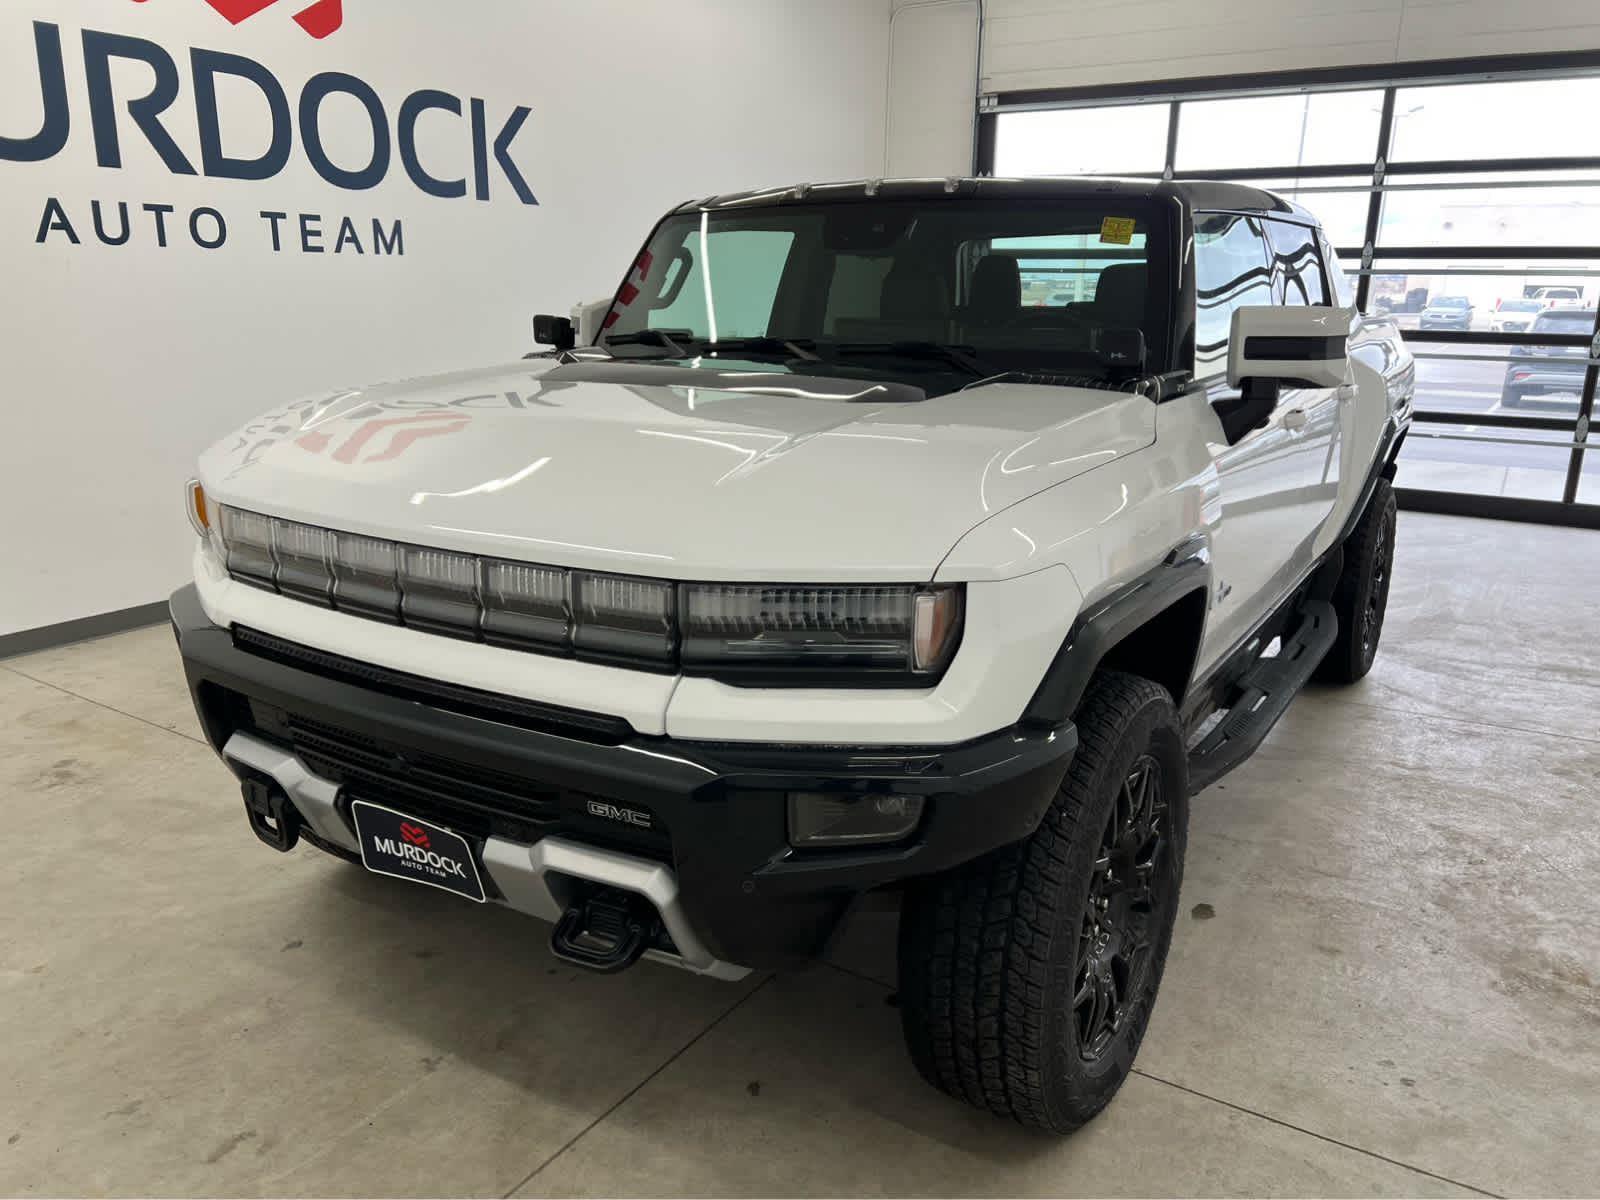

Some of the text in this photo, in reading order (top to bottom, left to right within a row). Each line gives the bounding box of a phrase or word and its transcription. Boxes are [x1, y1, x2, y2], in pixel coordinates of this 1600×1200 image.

[36, 197, 404, 256] AUTO TEAM
[587, 801, 651, 827] GMC
[373, 836, 466, 879] MURDOCK
[401, 860, 447, 878] AUTO TEAM
